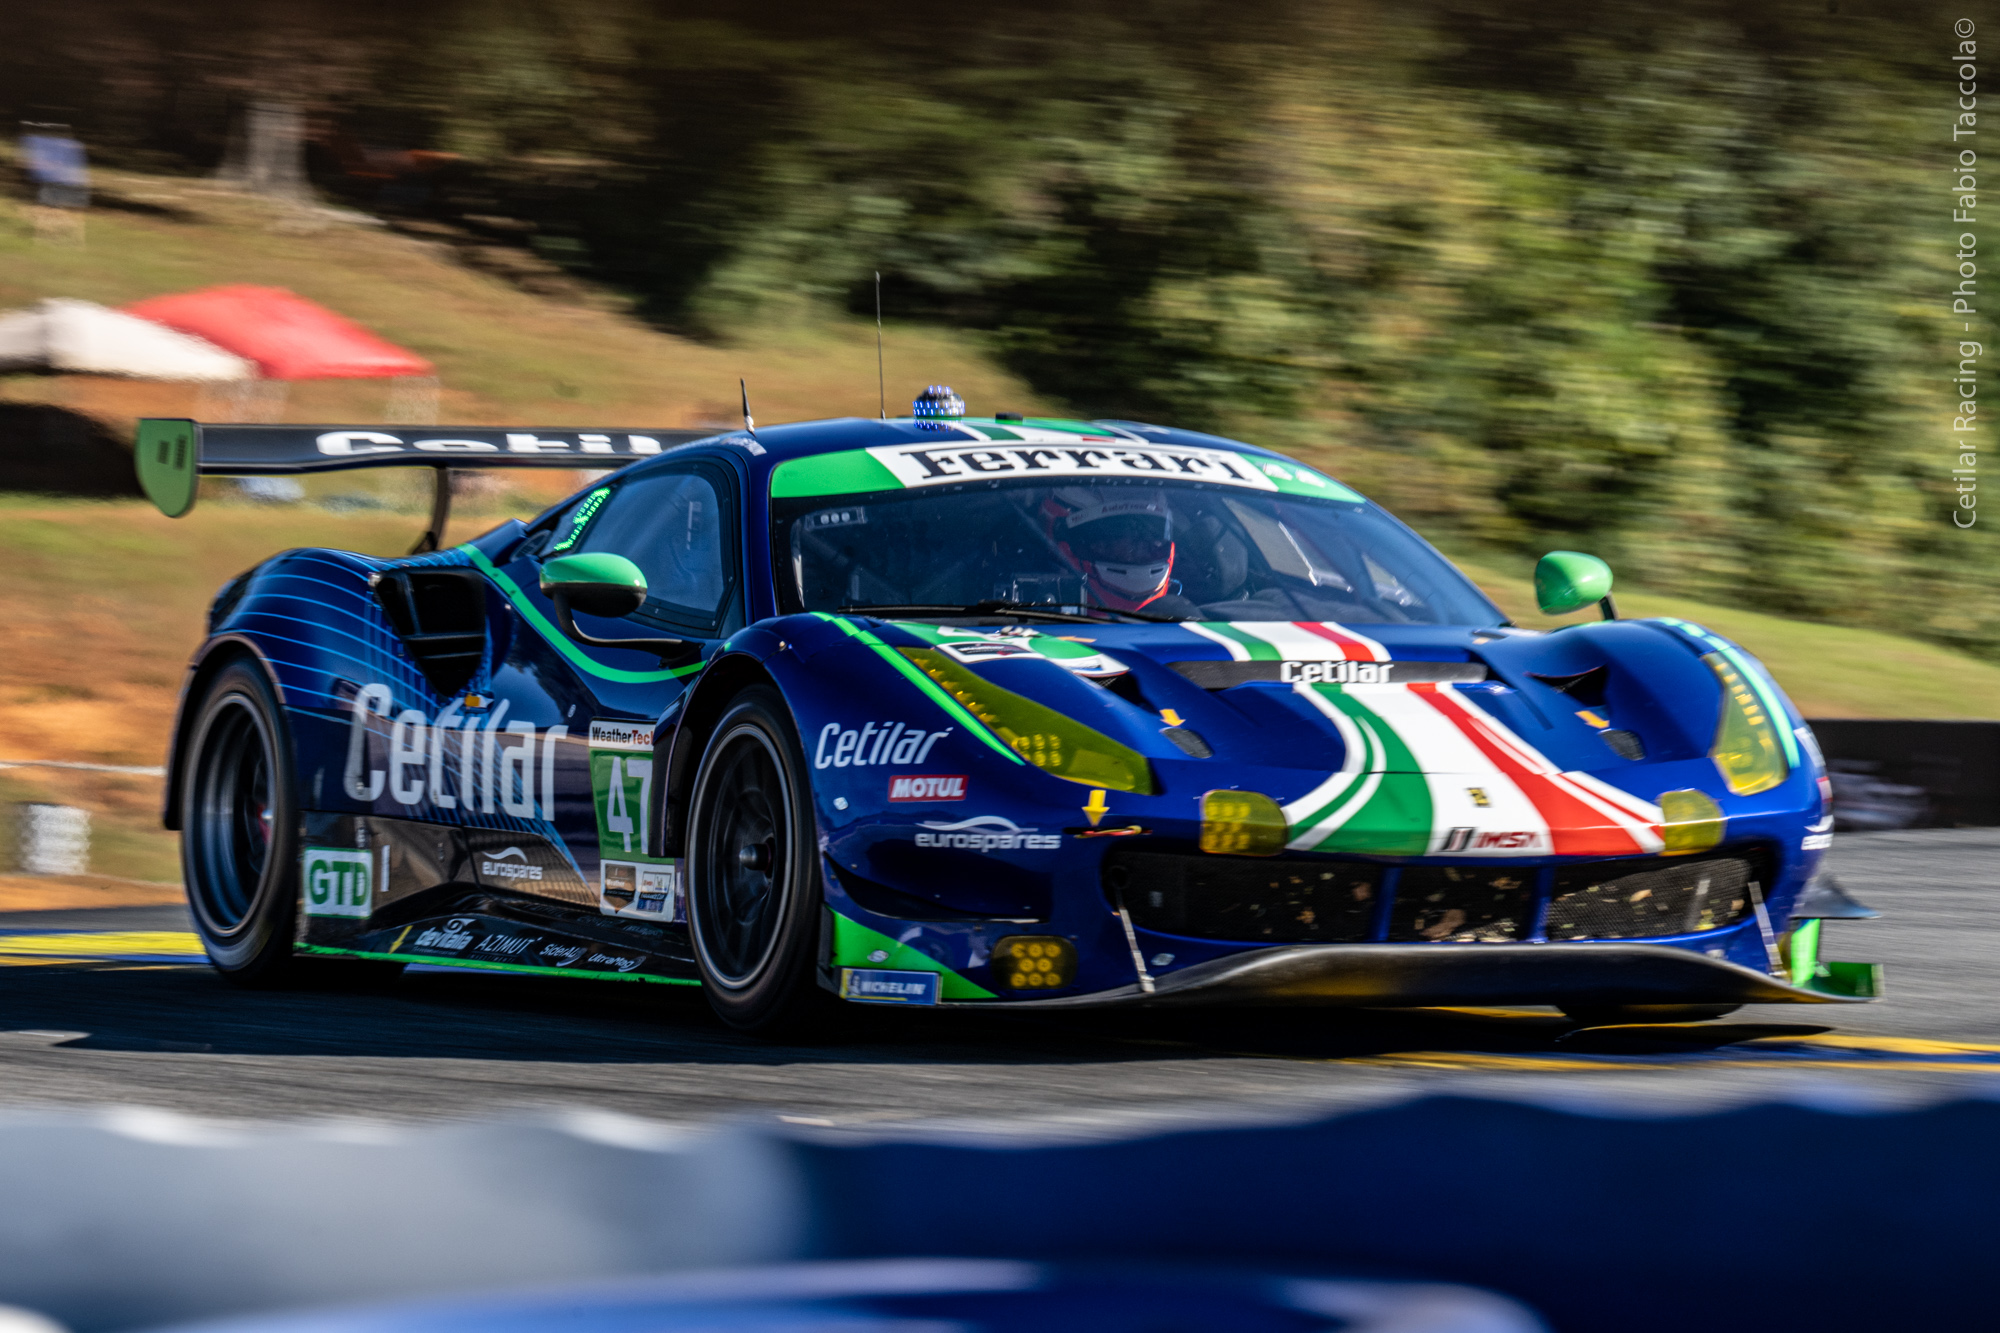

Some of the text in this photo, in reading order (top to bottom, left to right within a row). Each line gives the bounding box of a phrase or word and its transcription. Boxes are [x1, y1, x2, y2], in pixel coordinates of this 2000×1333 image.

[900, 449, 1253, 481] Ferrari
[1280, 660, 1395, 683] Cetilar
[343, 683, 569, 822] Cetilar
[814, 721, 954, 769] Cetilar
[890, 778, 965, 798] MOTUL
[606, 756, 654, 855] 47
[914, 832, 1062, 852] eurospares
[309, 859, 367, 906] GTD
[482, 861, 542, 881] eurospares
[474, 934, 535, 954] AZIMUT
[862, 981, 926, 995] MICHELIN
